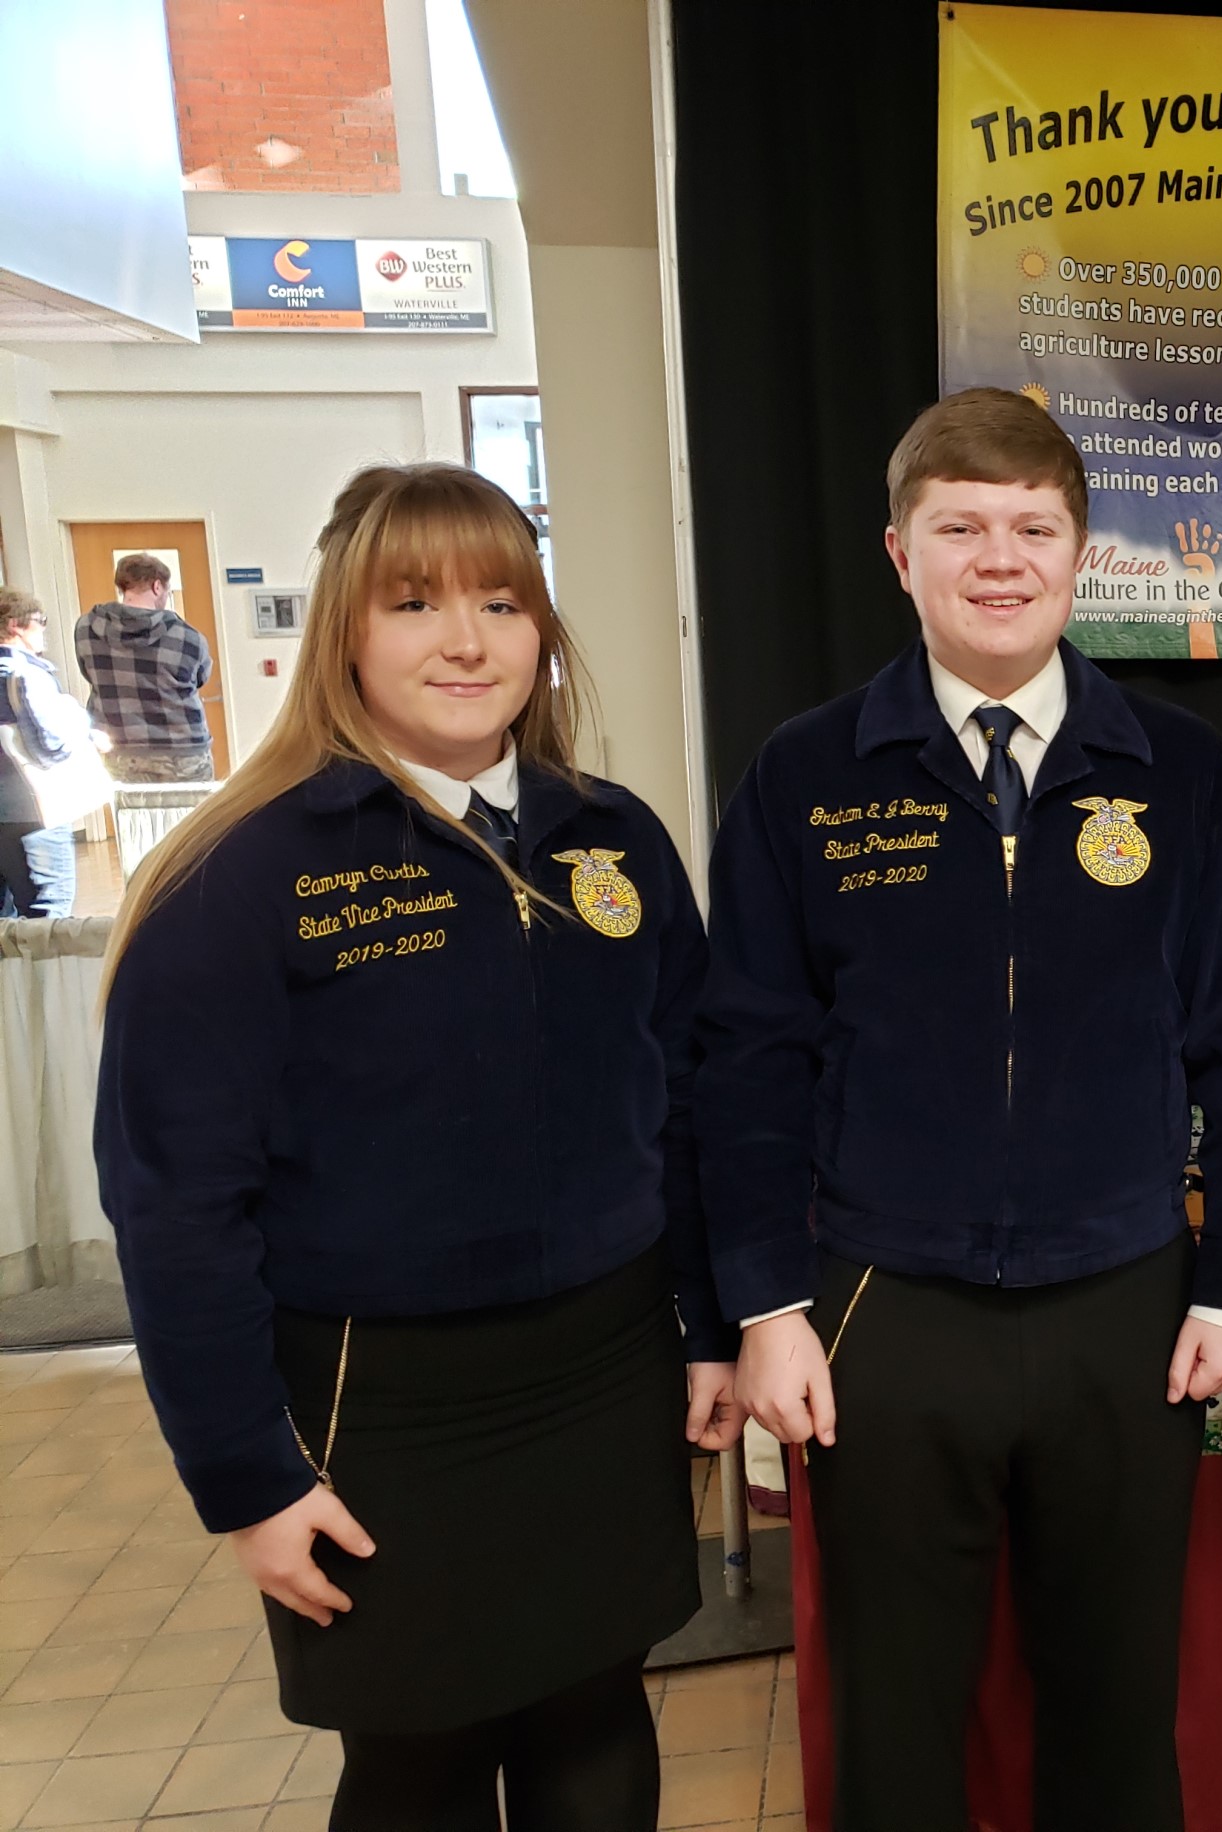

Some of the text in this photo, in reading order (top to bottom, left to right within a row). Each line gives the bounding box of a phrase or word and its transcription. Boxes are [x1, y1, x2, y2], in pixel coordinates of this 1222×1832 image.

[971, 90, 1124, 164] Thank
[965, 191, 1053, 237] Since
[1065, 173, 1146, 214] 2007
[380, 258, 404, 274] BW
[412, 260, 472, 273] Western
[426, 247, 458, 260] Best
[1058, 257, 1116, 284] Over
[1122, 260, 1222, 293] 350,000
[268, 284, 325, 298] Comfort
[287, 298, 308, 307] INN
[394, 299, 458, 309] WATERVILLE
[1018, 293, 1122, 323] students
[1128, 299, 1185, 326] have
[1018, 330, 1149, 361] agriculture
[1059, 393, 1168, 423] Hundreds
[1174, 401, 1199, 423] of
[1081, 432, 1181, 459] attended
[1165, 467, 1219, 494] each
[1076, 545, 1169, 577] Maine
[1146, 579, 1166, 601] in
[1174, 578, 1210, 602] the
[901, 798, 949, 822] Berry
[824, 829, 940, 860] State President
[296, 863, 430, 897] Camryn Curtis
[838, 864, 928, 892] 2019-2020
[299, 891, 459, 941] State Vice President
[335, 929, 446, 971] 2019-2020
